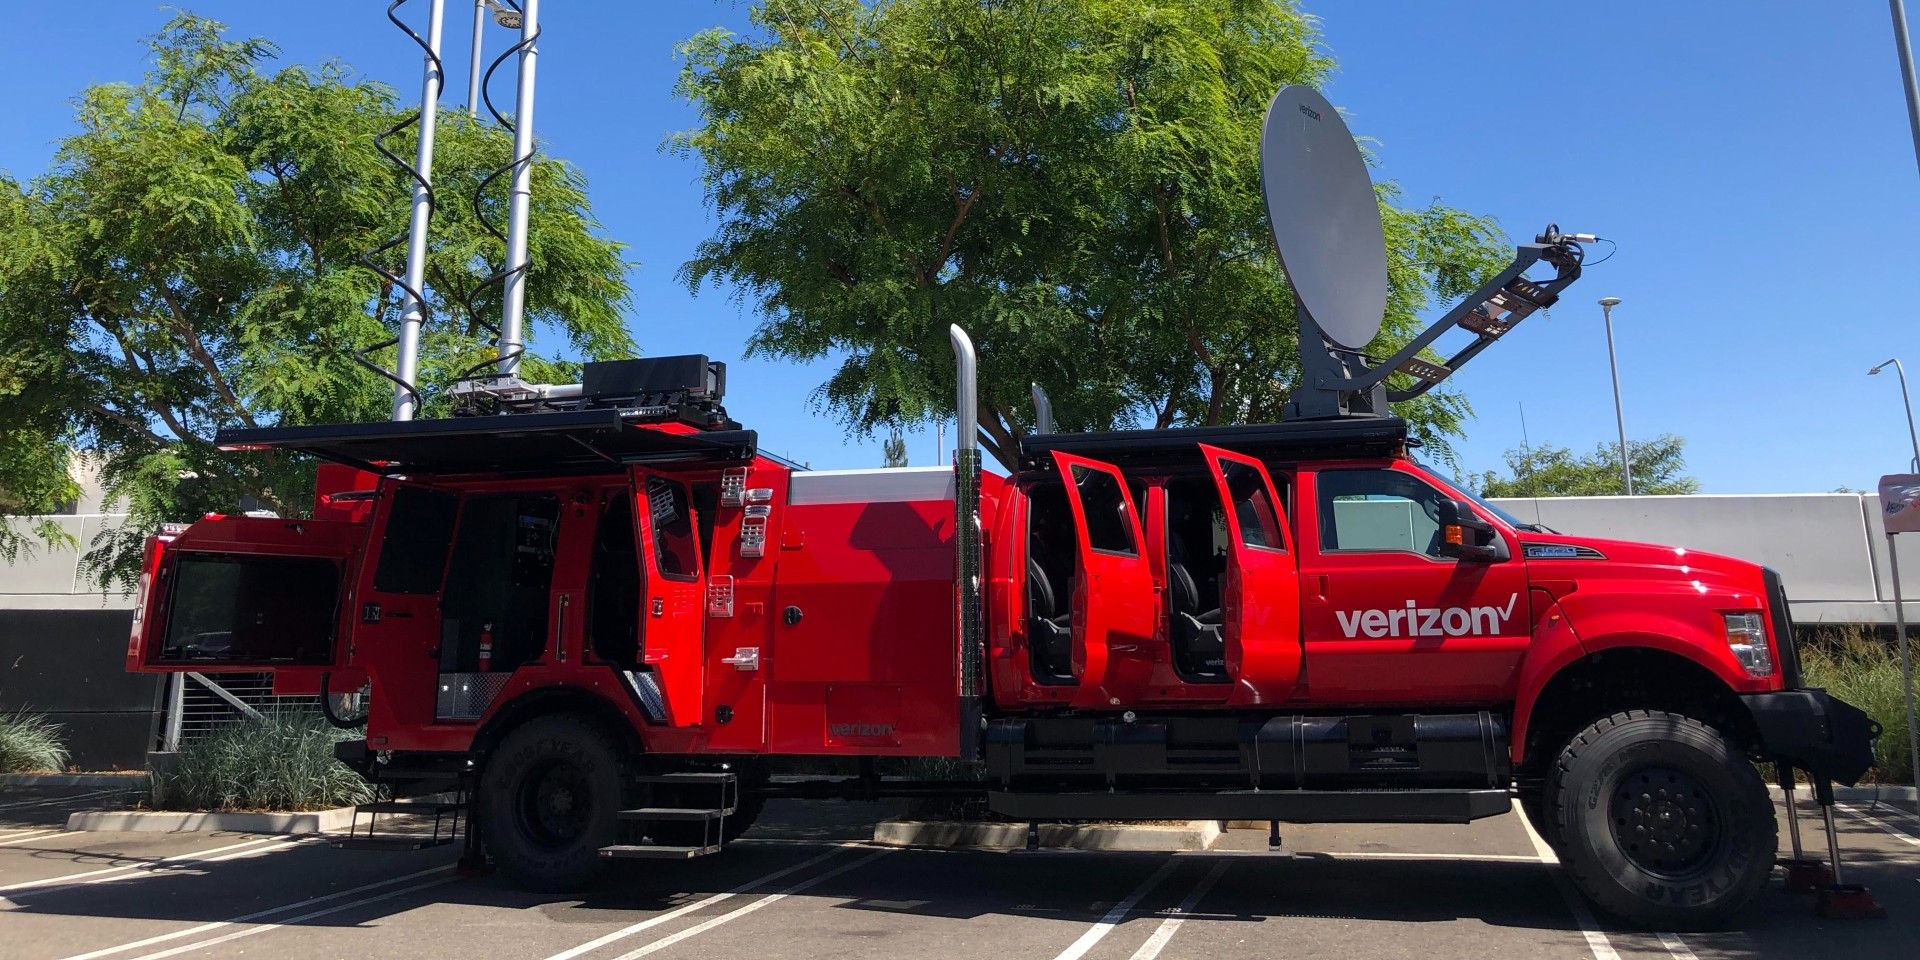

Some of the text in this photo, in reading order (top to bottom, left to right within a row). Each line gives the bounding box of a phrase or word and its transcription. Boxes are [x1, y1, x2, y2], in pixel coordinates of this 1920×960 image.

[1299, 104, 1320, 121] verizon
[1335, 599, 1501, 638] verizon
[1205, 658, 1225, 666] veriz
[831, 720, 894, 737] verizon
